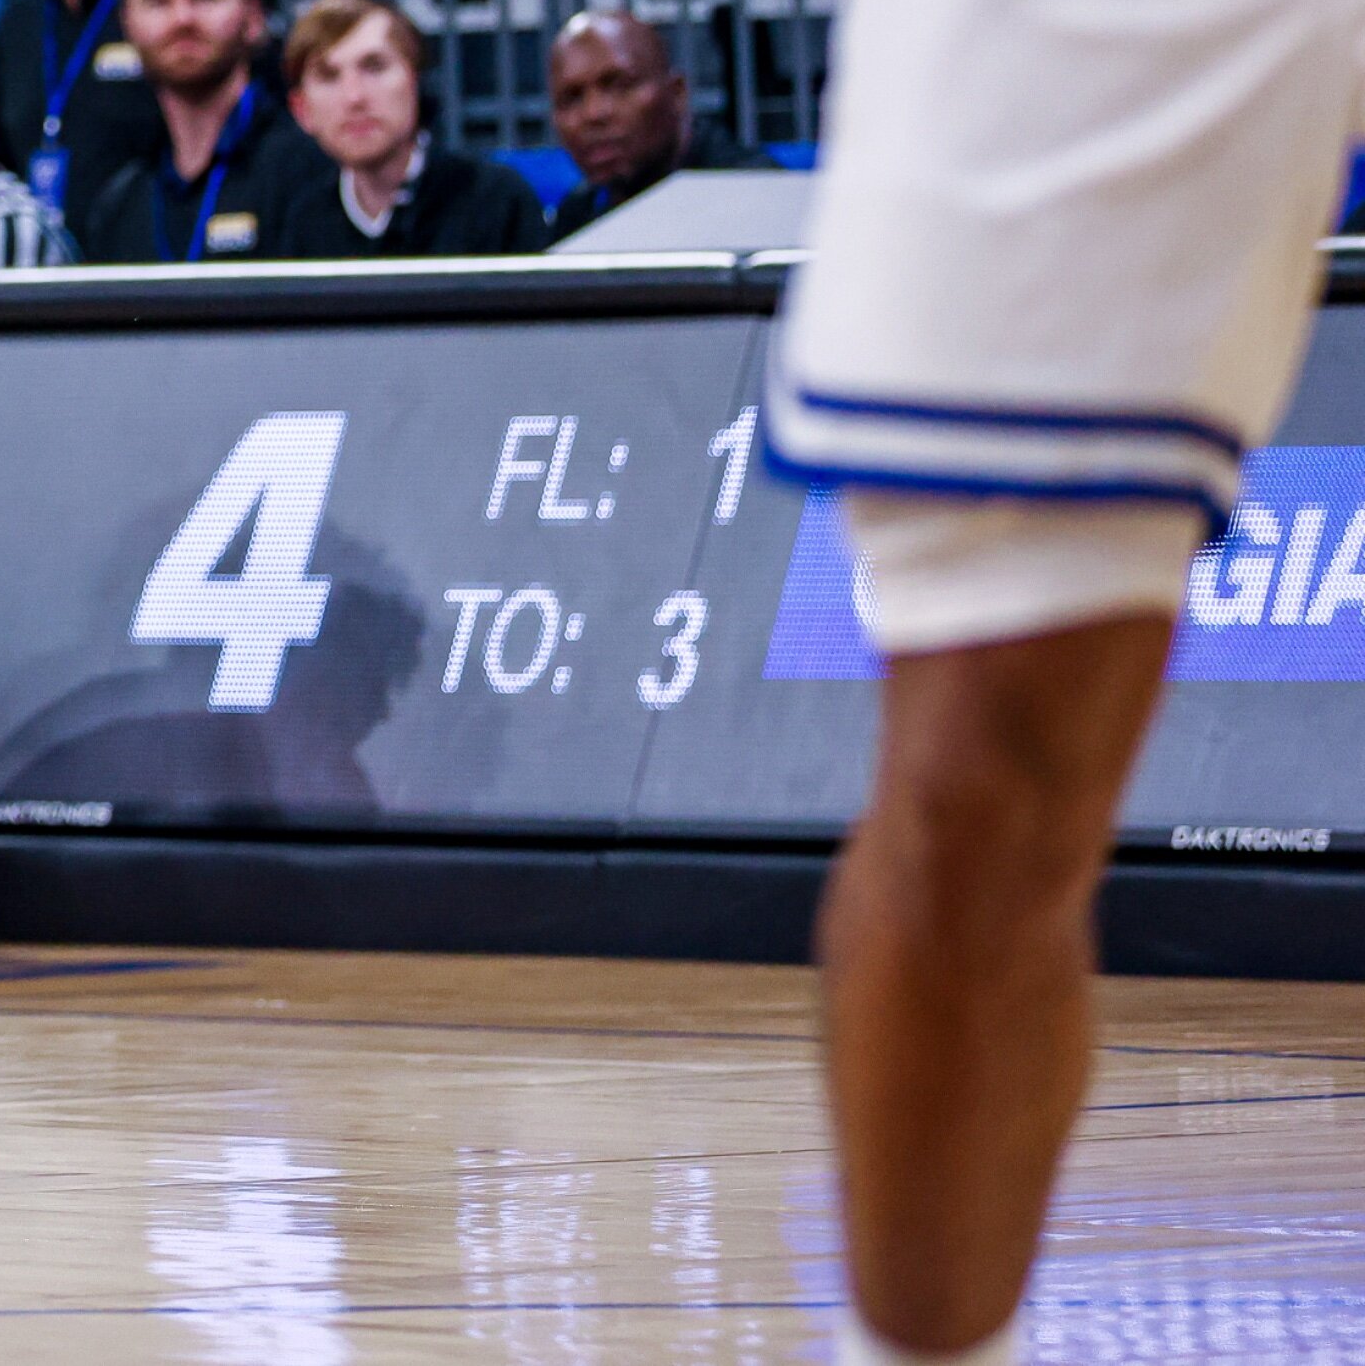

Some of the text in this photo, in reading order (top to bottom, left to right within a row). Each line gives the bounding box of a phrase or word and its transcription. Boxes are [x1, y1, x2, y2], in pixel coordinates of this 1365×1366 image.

[484, 405, 759, 526] FL: 1
[130, 409, 349, 715] 4
[440, 587, 709, 711] TO: 3
